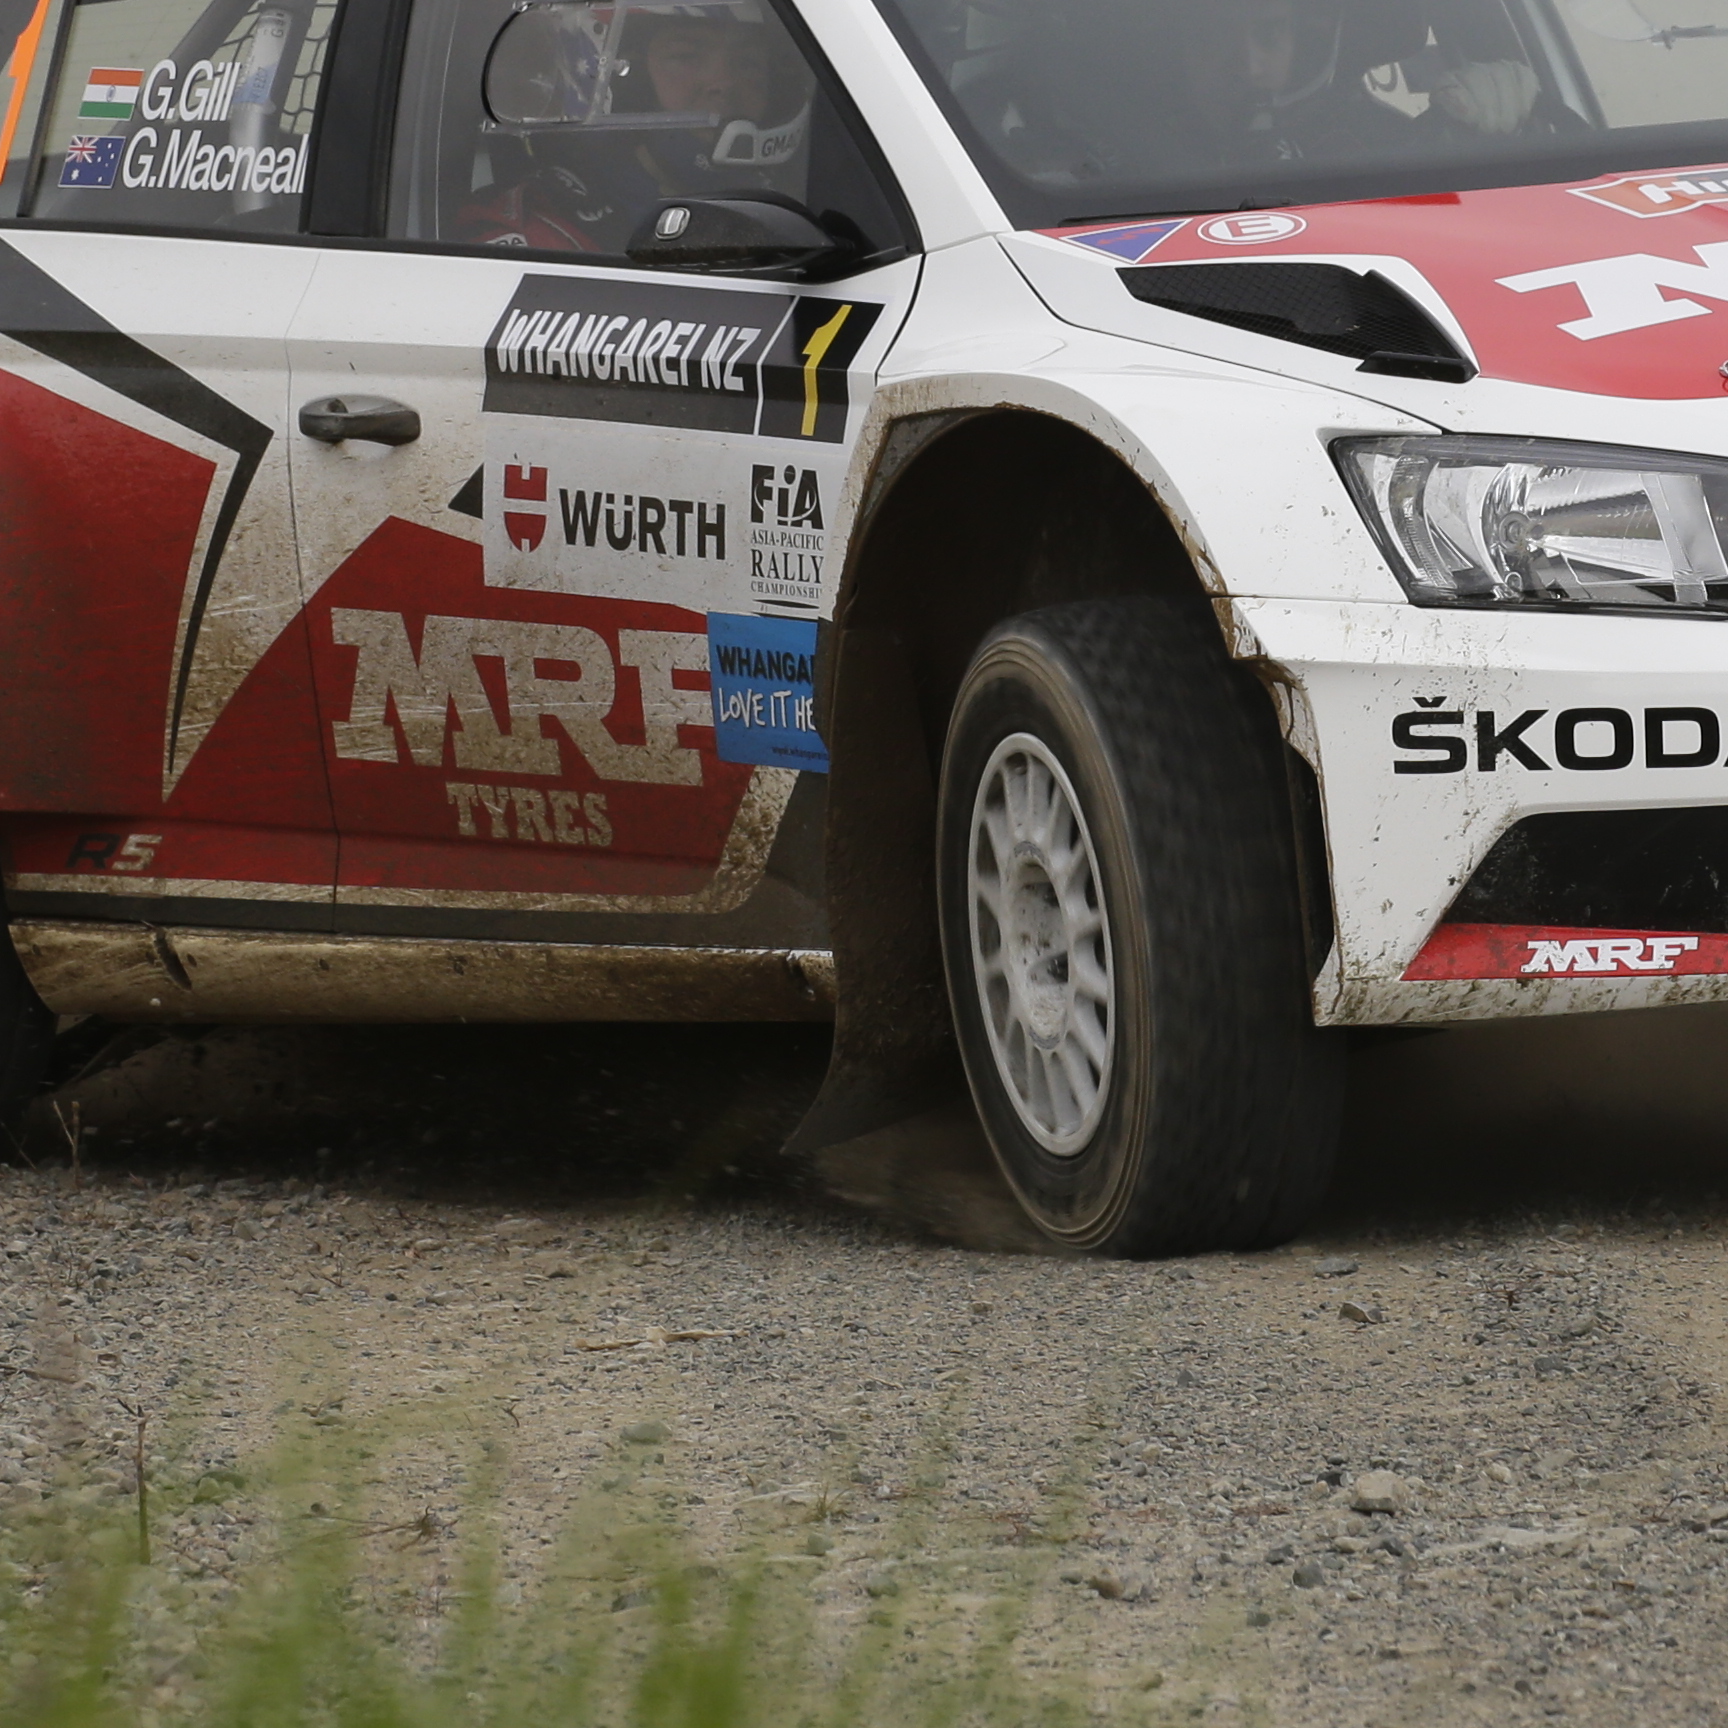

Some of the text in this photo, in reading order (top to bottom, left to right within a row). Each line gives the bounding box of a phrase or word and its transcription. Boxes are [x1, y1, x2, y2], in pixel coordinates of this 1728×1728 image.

[142, 59, 240, 121] G.Gill
[497, 309, 761, 392] WHANGAREI NZ
[801, 305, 852, 436] 1
[559, 487, 726, 560] WÜRTH
[750, 548, 824, 584] RALLY
[331, 607, 713, 787] MRF
[719, 687, 766, 729] LOVE
[770, 690, 792, 727] IT
[445, 781, 613, 847] TYRES
[1521, 937, 1698, 971] MRF
